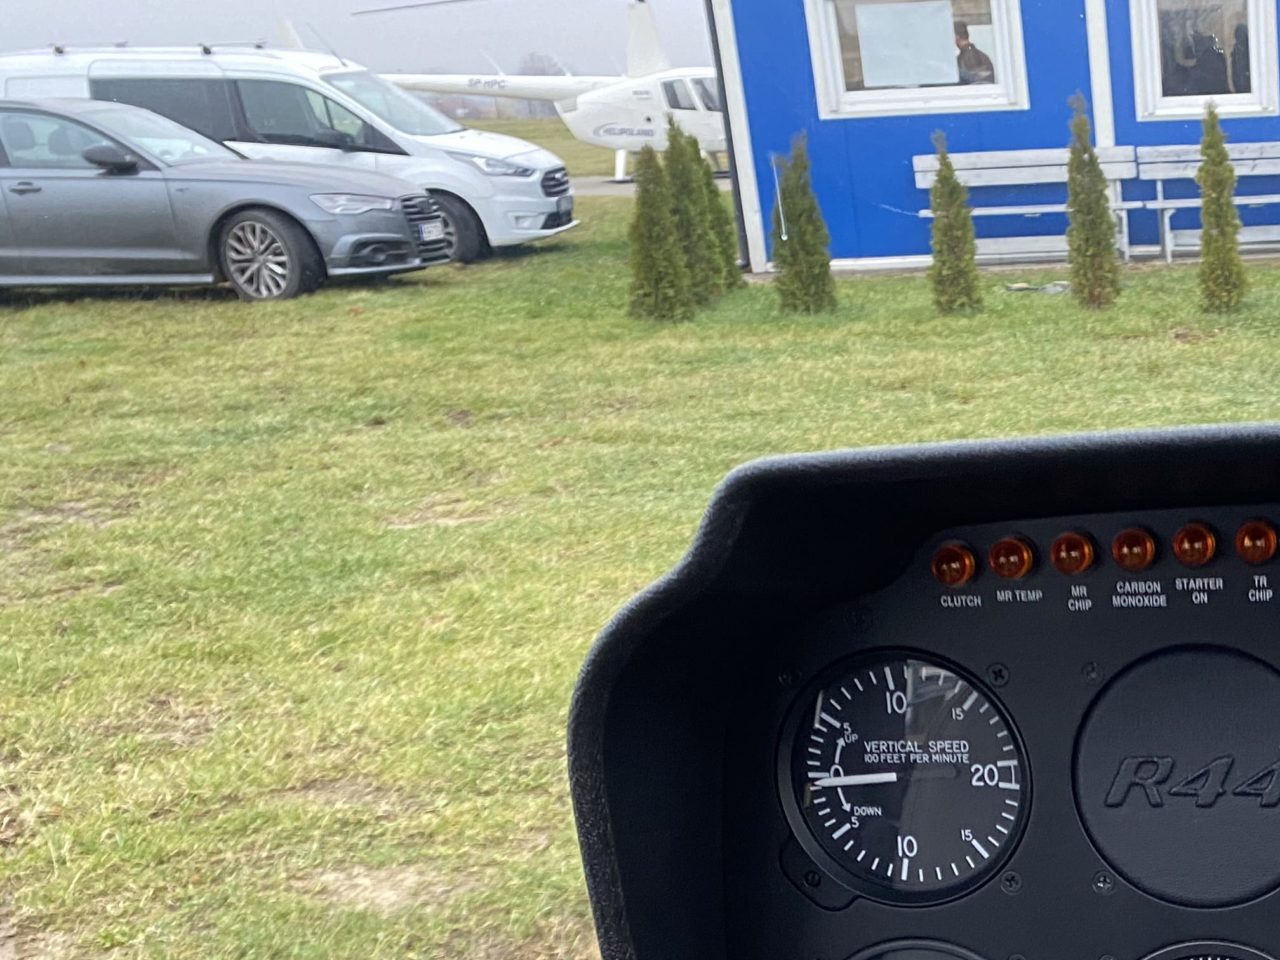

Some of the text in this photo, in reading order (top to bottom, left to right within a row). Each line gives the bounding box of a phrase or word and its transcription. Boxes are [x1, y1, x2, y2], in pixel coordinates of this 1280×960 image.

[1116, 581, 1161, 593] CARBON
[1175, 578, 1223, 590] STARTER
[1253, 576, 1267, 587] TR
[997, 590, 1043, 601] MR TEMP
[1071, 585, 1087, 597] MR
[1249, 589, 1273, 601] CHIP
[940, 595, 982, 607] CLUTCH
[1112, 595, 1167, 607] MONOXIDE
[1192, 592, 1208, 604] ON
[1068, 599, 1092, 611] CHIP
[845, 733, 858, 744] UP
[864, 740, 969, 753] VERTICAL SPEED
[864, 753, 969, 763] 100 FEET PER MINUTE
[970, 763, 999, 786] 20
[854, 806, 882, 816] DOWN
